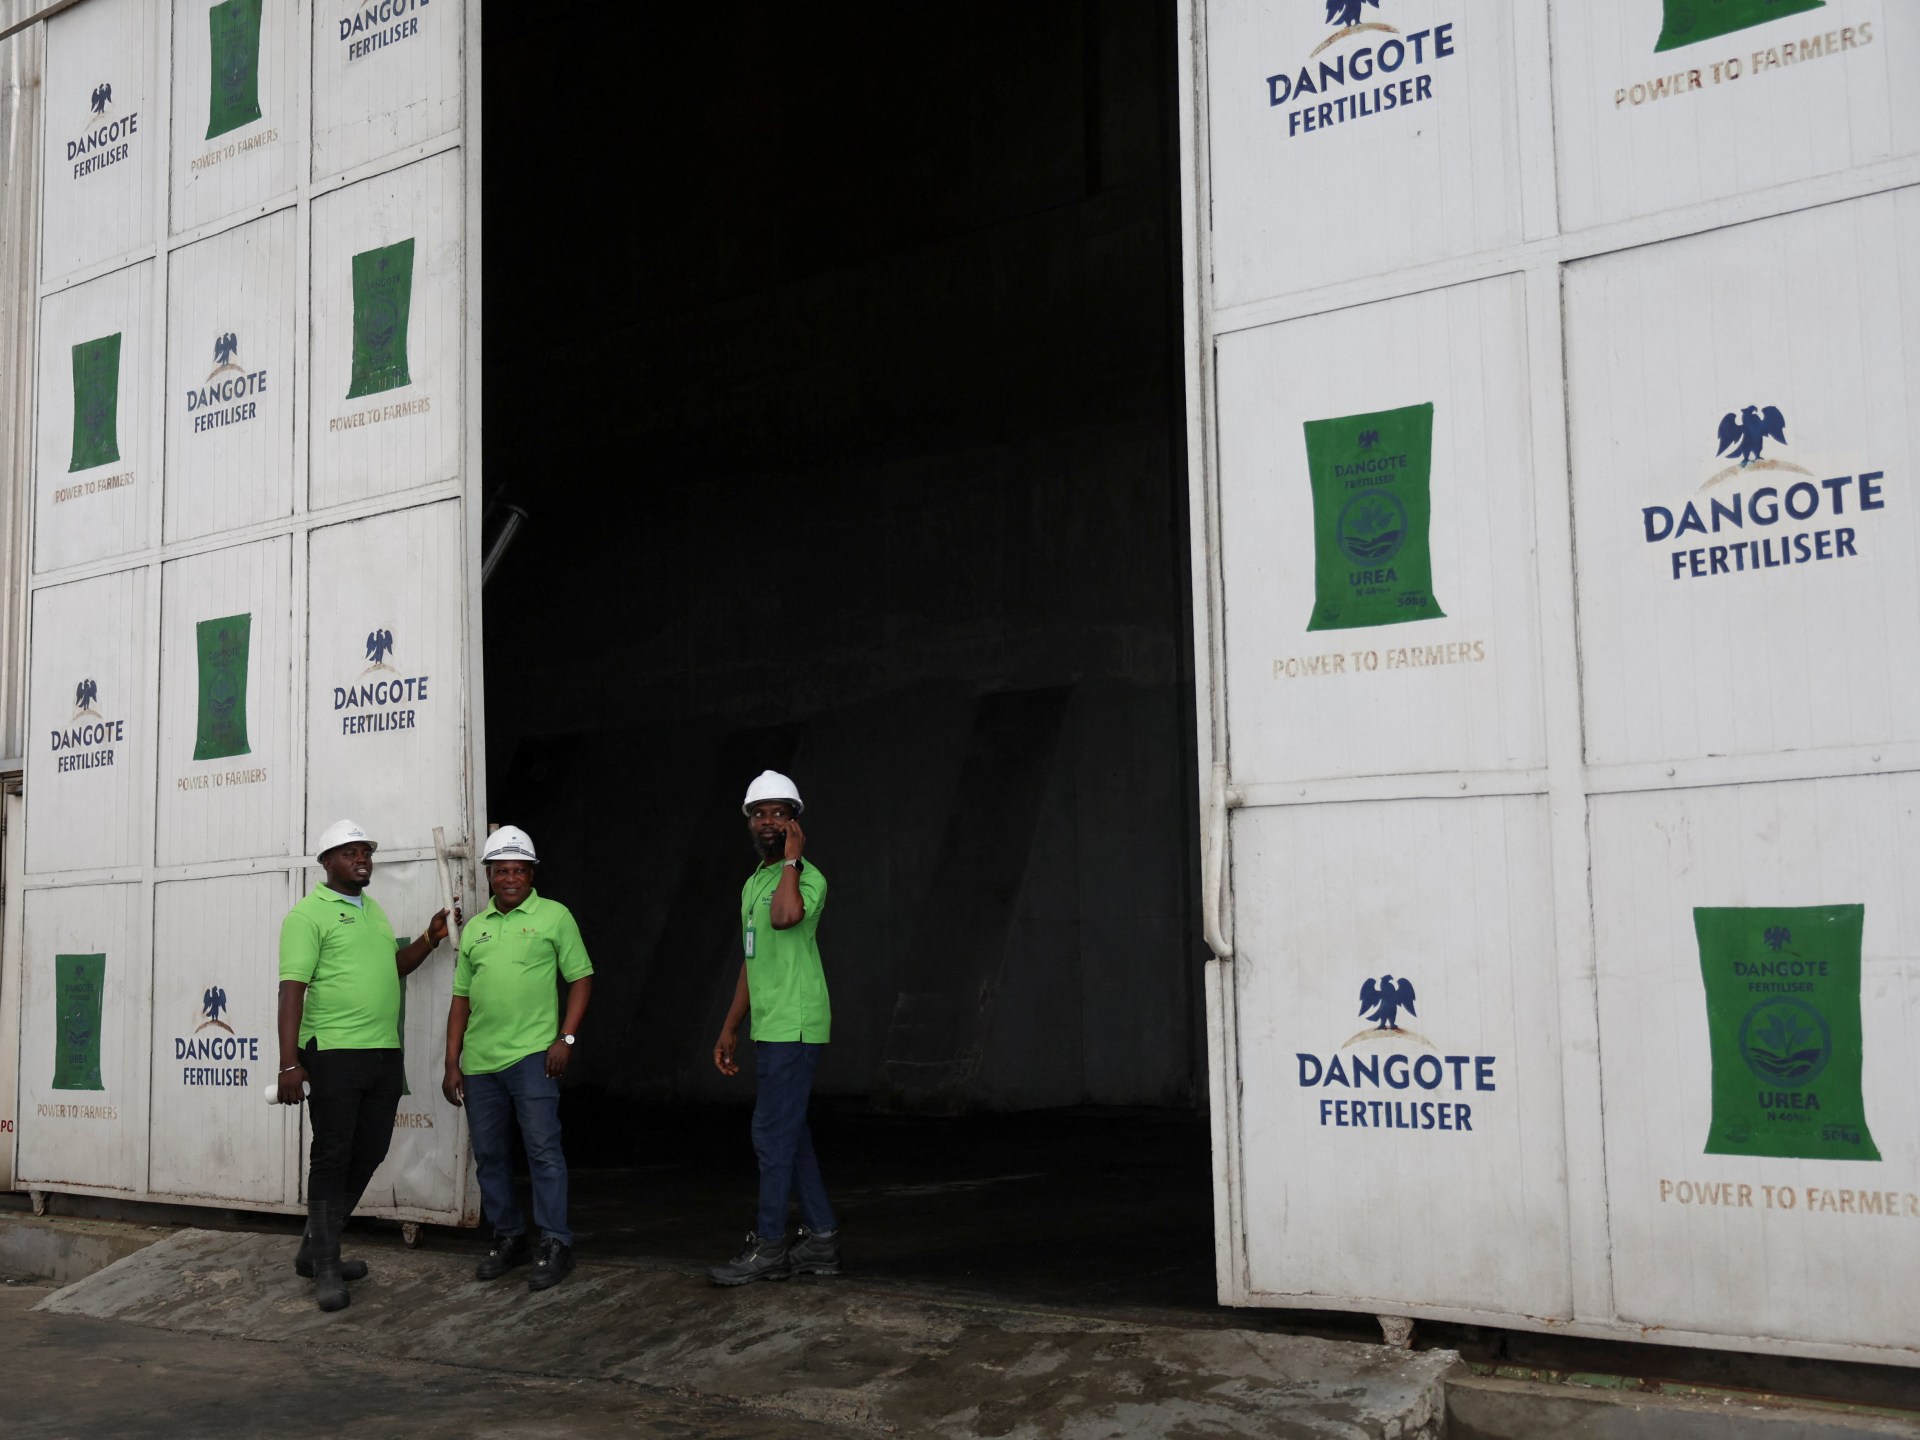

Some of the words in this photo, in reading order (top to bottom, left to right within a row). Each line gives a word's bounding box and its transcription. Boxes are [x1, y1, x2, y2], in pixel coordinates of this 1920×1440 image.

[339, 0, 430, 41] DANGO
[348, 17, 418, 61] FERTILISER
[1267, 22, 1455, 107] DANGOTE
[1614, 68, 1704, 110] POWER
[1709, 56, 1744, 85] TO
[1750, 22, 1875, 75] FARMERS
[1288, 75, 1432, 137] FERTILISER
[67, 113, 138, 161] DANGOTE
[191, 152, 221, 173] POWER
[224, 145, 235, 159] TO
[238, 128, 278, 154] FARMERS
[74, 143, 129, 180] FERTILISER
[187, 370, 267, 412] DANGOTE
[194, 402, 256, 433] FERTILISER
[329, 414, 365, 433] POWER
[368, 409, 380, 425] TO
[383, 397, 431, 422] FARMERS
[1335, 454, 1407, 478] DANGOTE
[1345, 474, 1395, 489] FERTILISER
[55, 484, 82, 503] POWER
[85, 481, 96, 495] TO
[98, 472, 135, 493] FARMERS
[1641, 471, 1885, 543] DANGOTE
[1672, 527, 1858, 580] FERTILISER
[1350, 568, 1397, 586] UREA
[1272, 653, 1346, 679] POWER
[1351, 650, 1378, 672] TO
[1386, 640, 1485, 669] FARMERS
[334, 676, 429, 710] DANGOTE
[51, 720, 124, 751] DANGOTE
[342, 710, 415, 735] FERTILISER
[58, 750, 114, 773] FERTILISER
[178, 777, 209, 791] POWER
[212, 774, 223, 787] TO
[226, 768, 267, 786] FARMERS
[1733, 961, 1828, 977] DANGOTE
[1748, 982, 1814, 993] FERTILISER
[175, 1037, 259, 1061] DANGOTE
[183, 1067, 248, 1087] FERTILISER
[1296, 1053, 1496, 1091] DANGOTE
[38, 1104, 66, 1118] POWER
[67, 1104, 78, 1118] TO
[80, 1105, 118, 1120] FARMERS
[1320, 1100, 1473, 1131] FERTILISER
[1758, 1092, 1820, 1110] UREA
[1767, 1112, 1776, 1121] N
[394, 1113, 433, 1128] RMERS
[1822, 1129, 1860, 1145] 50kg
[1659, 1178, 1753, 1208] POWER
[1761, 1185, 1796, 1210] TO
